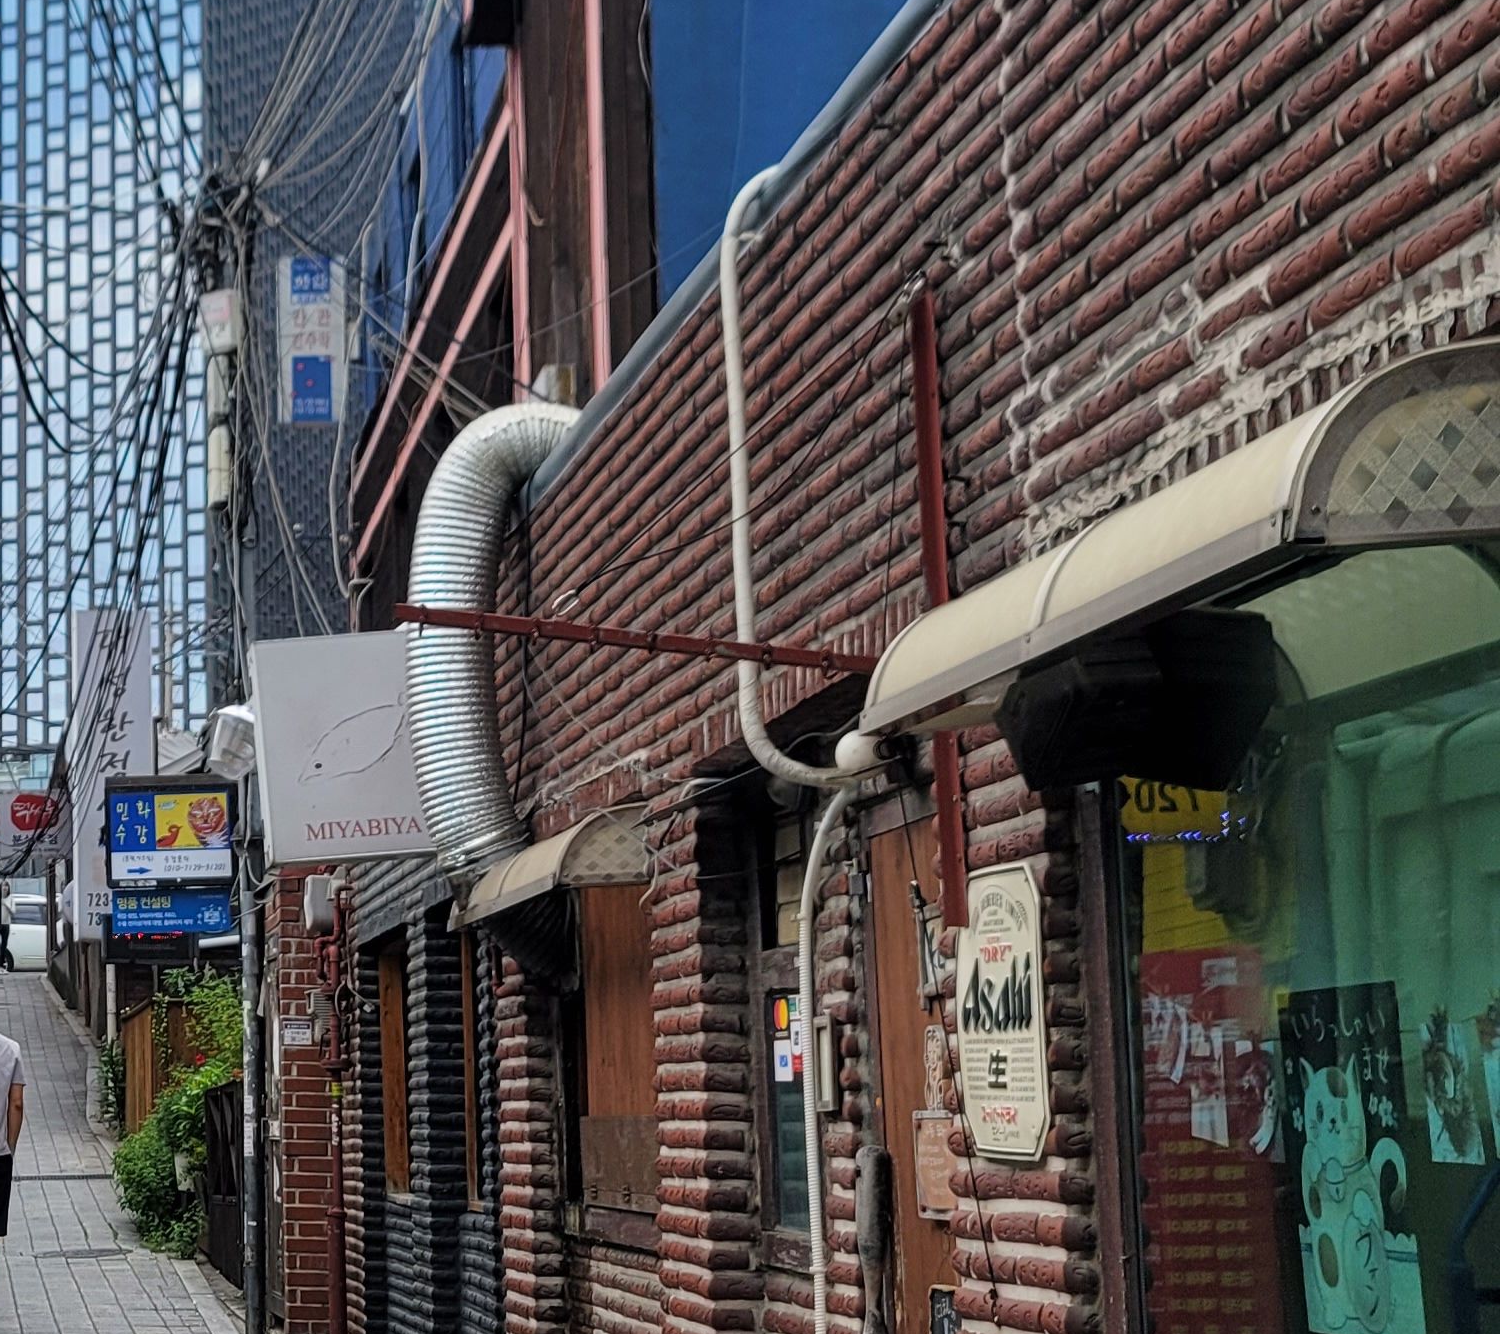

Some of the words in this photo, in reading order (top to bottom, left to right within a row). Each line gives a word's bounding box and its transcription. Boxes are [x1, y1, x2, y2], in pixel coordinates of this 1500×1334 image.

[115, 824, 149, 845] 수강
[306, 816, 422, 841] MIYABIYA
[959, 951, 1034, 1034] Asahi
[988, 1049, 1008, 1089] 生
